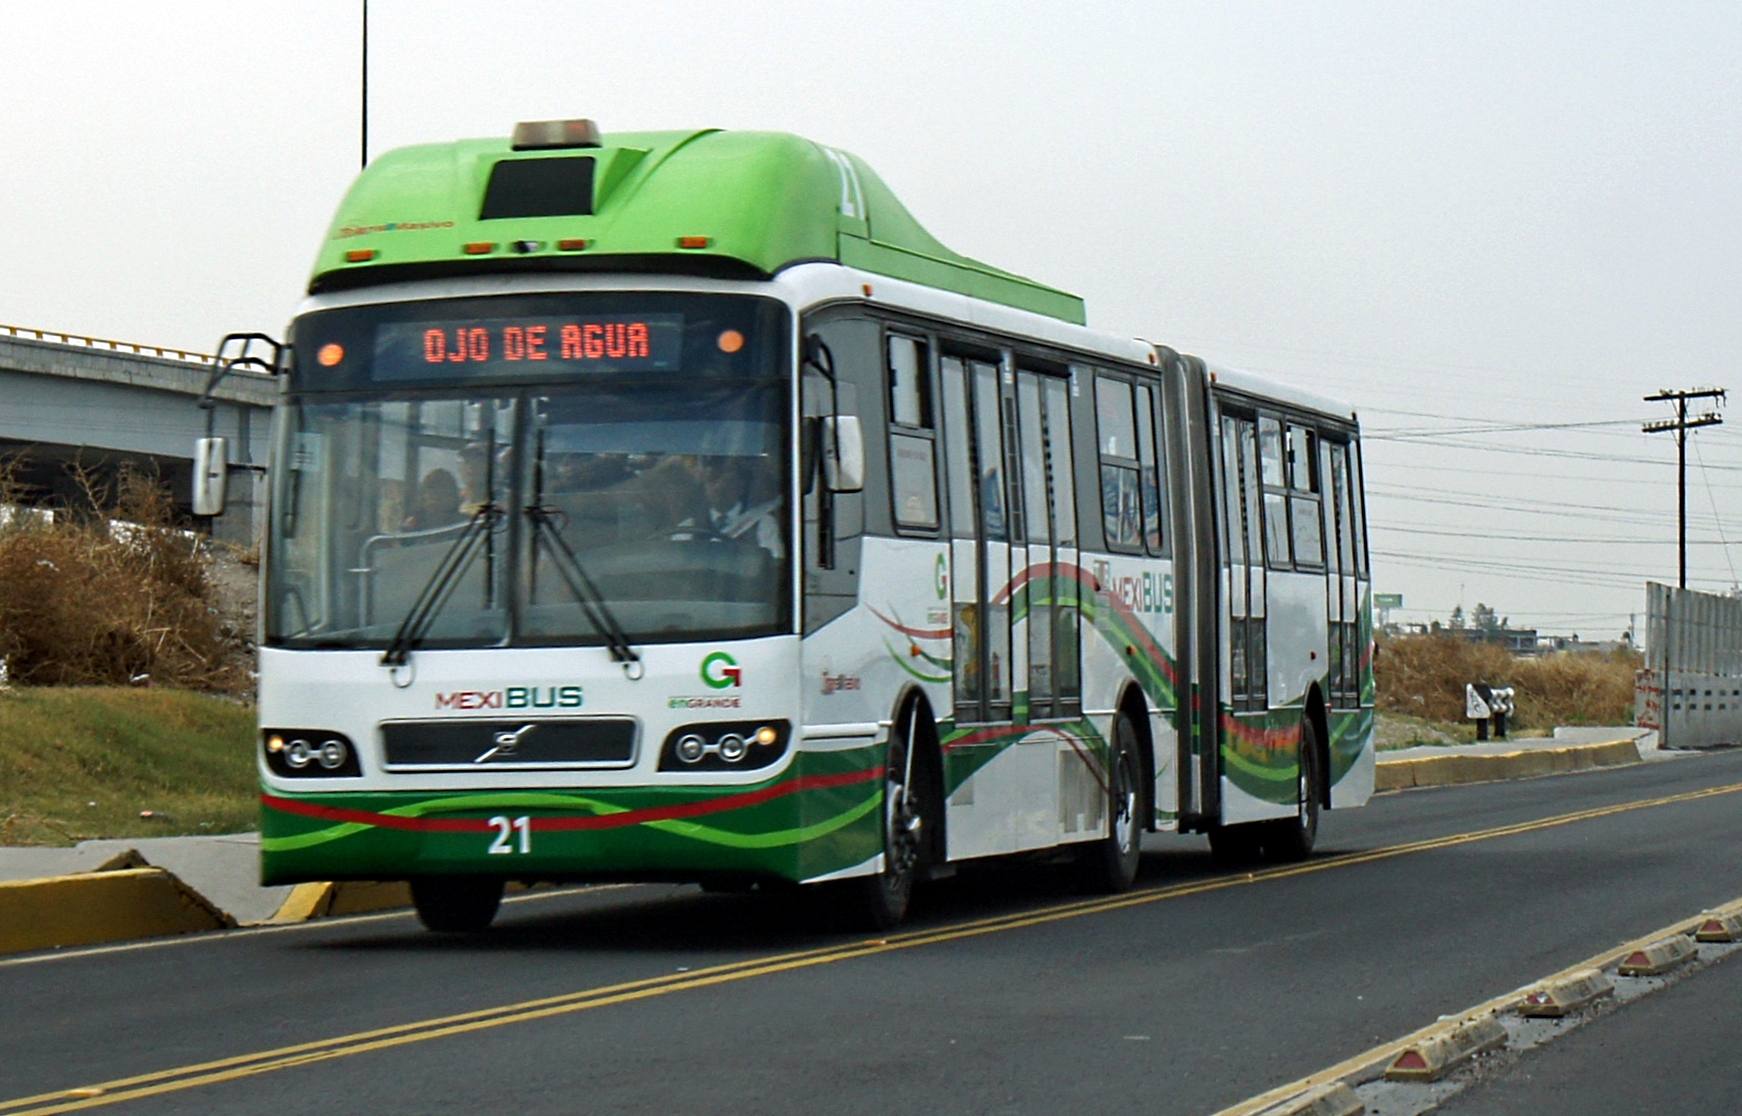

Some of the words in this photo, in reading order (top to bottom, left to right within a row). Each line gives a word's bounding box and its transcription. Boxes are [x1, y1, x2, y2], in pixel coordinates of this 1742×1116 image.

[424, 328, 490, 363] OJO
[503, 326, 548, 361] DE
[560, 322, 649, 359] AGUA
[1112, 571, 1173, 614] MEXIBUS
[434, 686, 583, 710] MEXIBUS
[487, 815, 531, 855] 21
